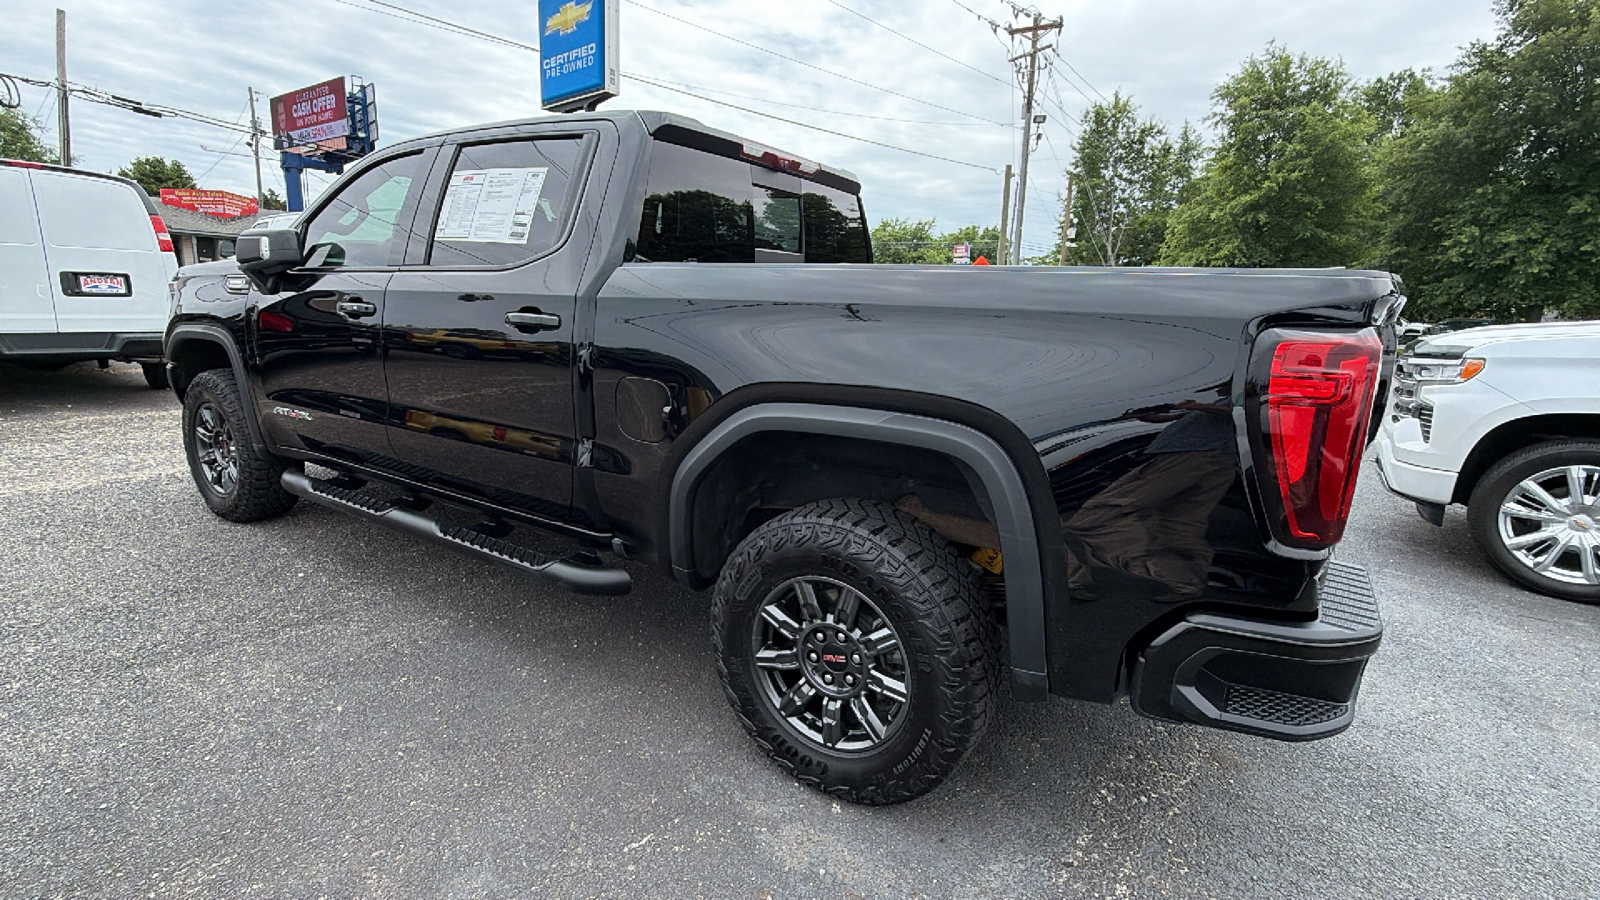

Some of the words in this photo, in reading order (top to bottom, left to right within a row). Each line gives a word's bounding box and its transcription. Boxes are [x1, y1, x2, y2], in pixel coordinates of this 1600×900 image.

[543, 43, 596, 69] CERTIFIED
[546, 56, 594, 79] PRE-OWNED
[296, 86, 330, 103] GUARANTEED
[292, 100, 311, 118] CASH
[312, 94, 336, 112] OFFER
[304, 114, 318, 125] YOUR
[83, 277, 123, 288] ANDEAN
[822, 654, 847, 663] GMC
